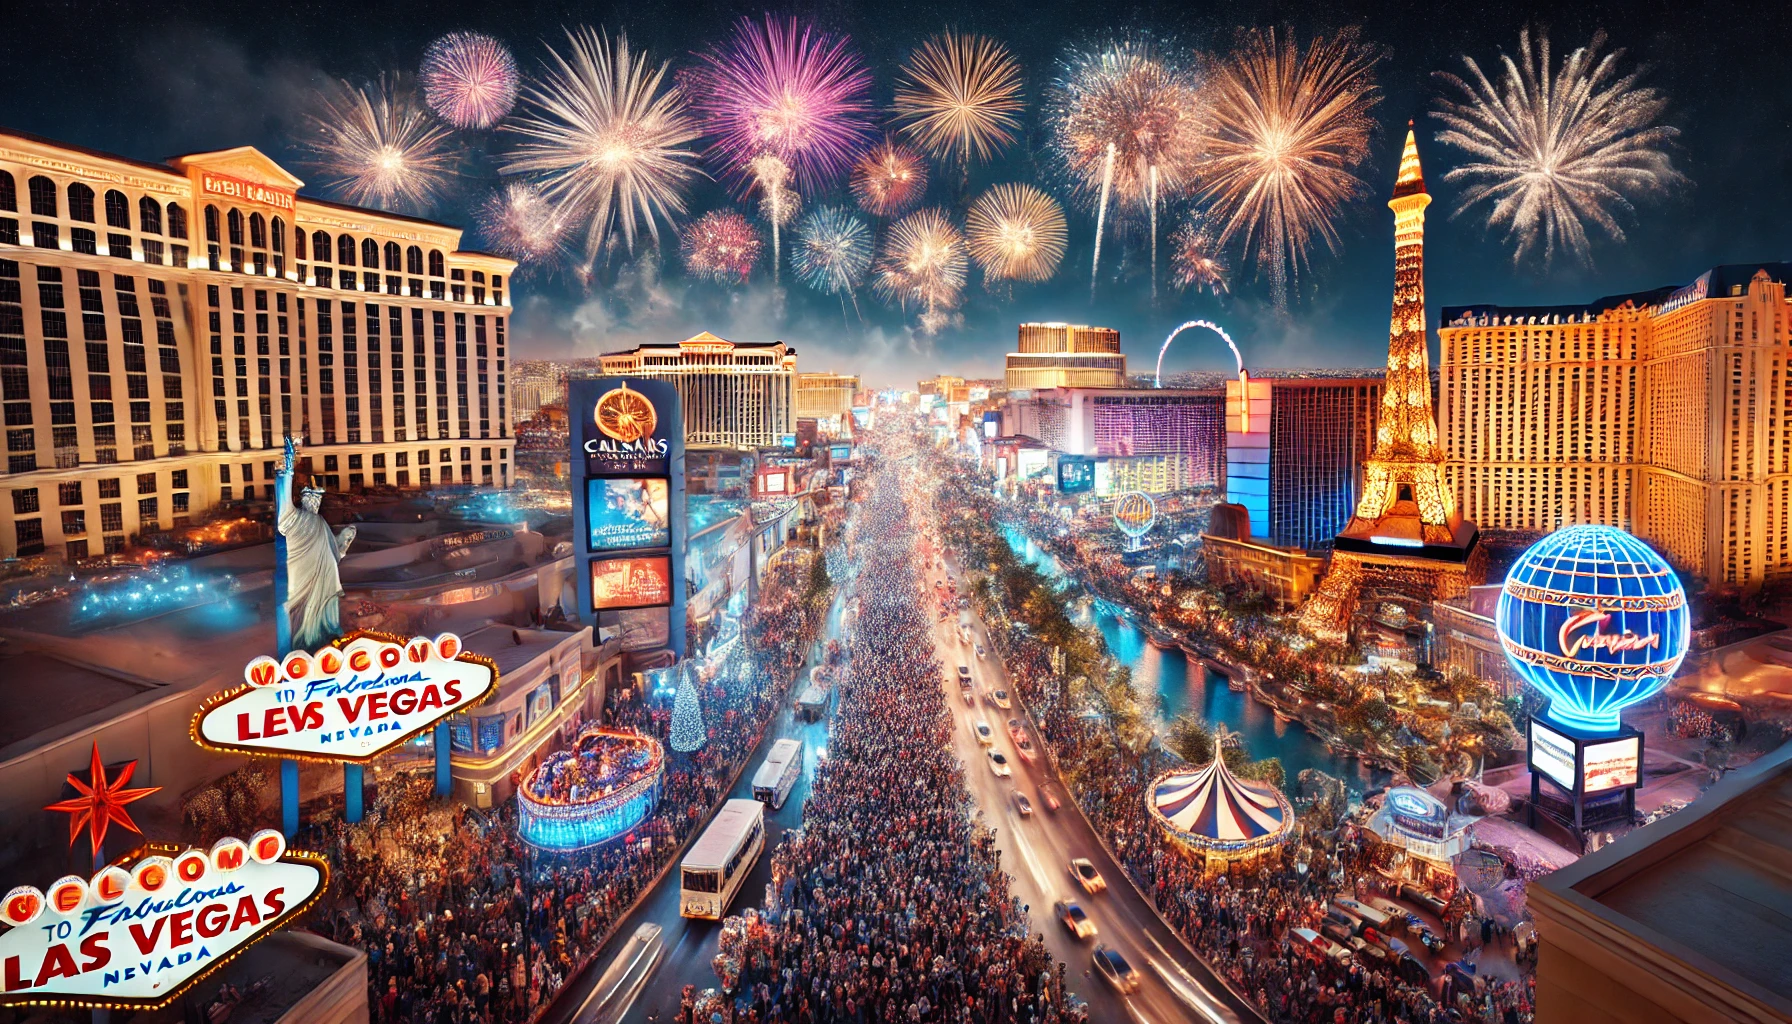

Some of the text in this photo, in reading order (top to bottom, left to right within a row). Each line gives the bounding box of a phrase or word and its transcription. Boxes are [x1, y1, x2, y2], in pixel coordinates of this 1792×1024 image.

[337, 679, 463, 725] VEGAS
[4, 887, 286, 992] LAS VEGAS
[42, 920, 72, 943] TO
[103, 945, 212, 988] NEVADA
